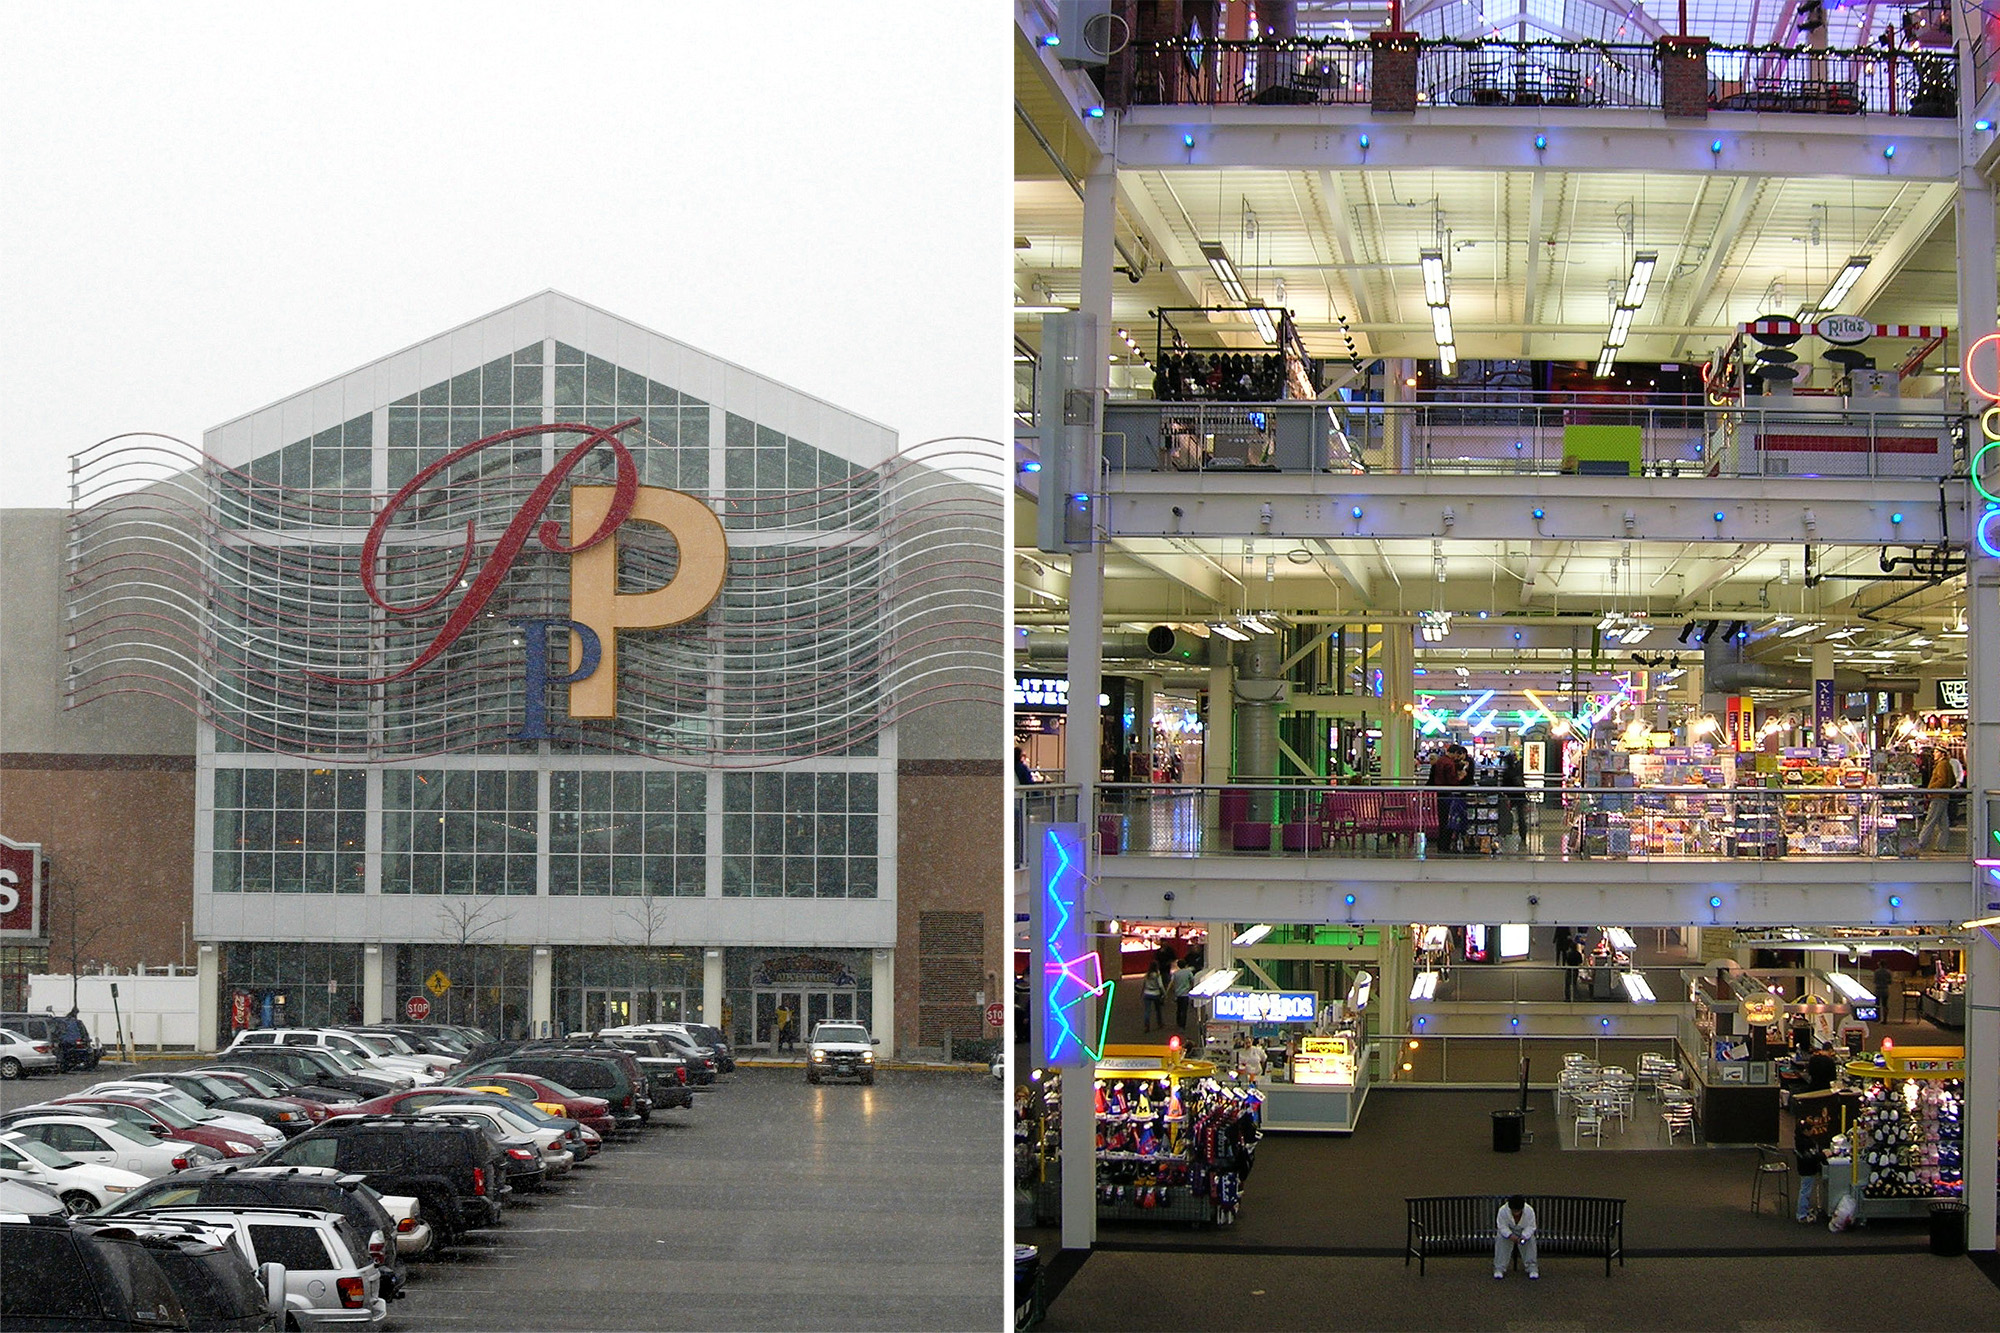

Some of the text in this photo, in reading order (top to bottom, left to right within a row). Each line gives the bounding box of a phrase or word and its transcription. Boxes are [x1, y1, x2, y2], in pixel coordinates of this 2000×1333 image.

[1828, 319, 1865, 336] Rita's
[408, 1002, 428, 1013] STOP
[987, 1010, 1003, 1020] STO
